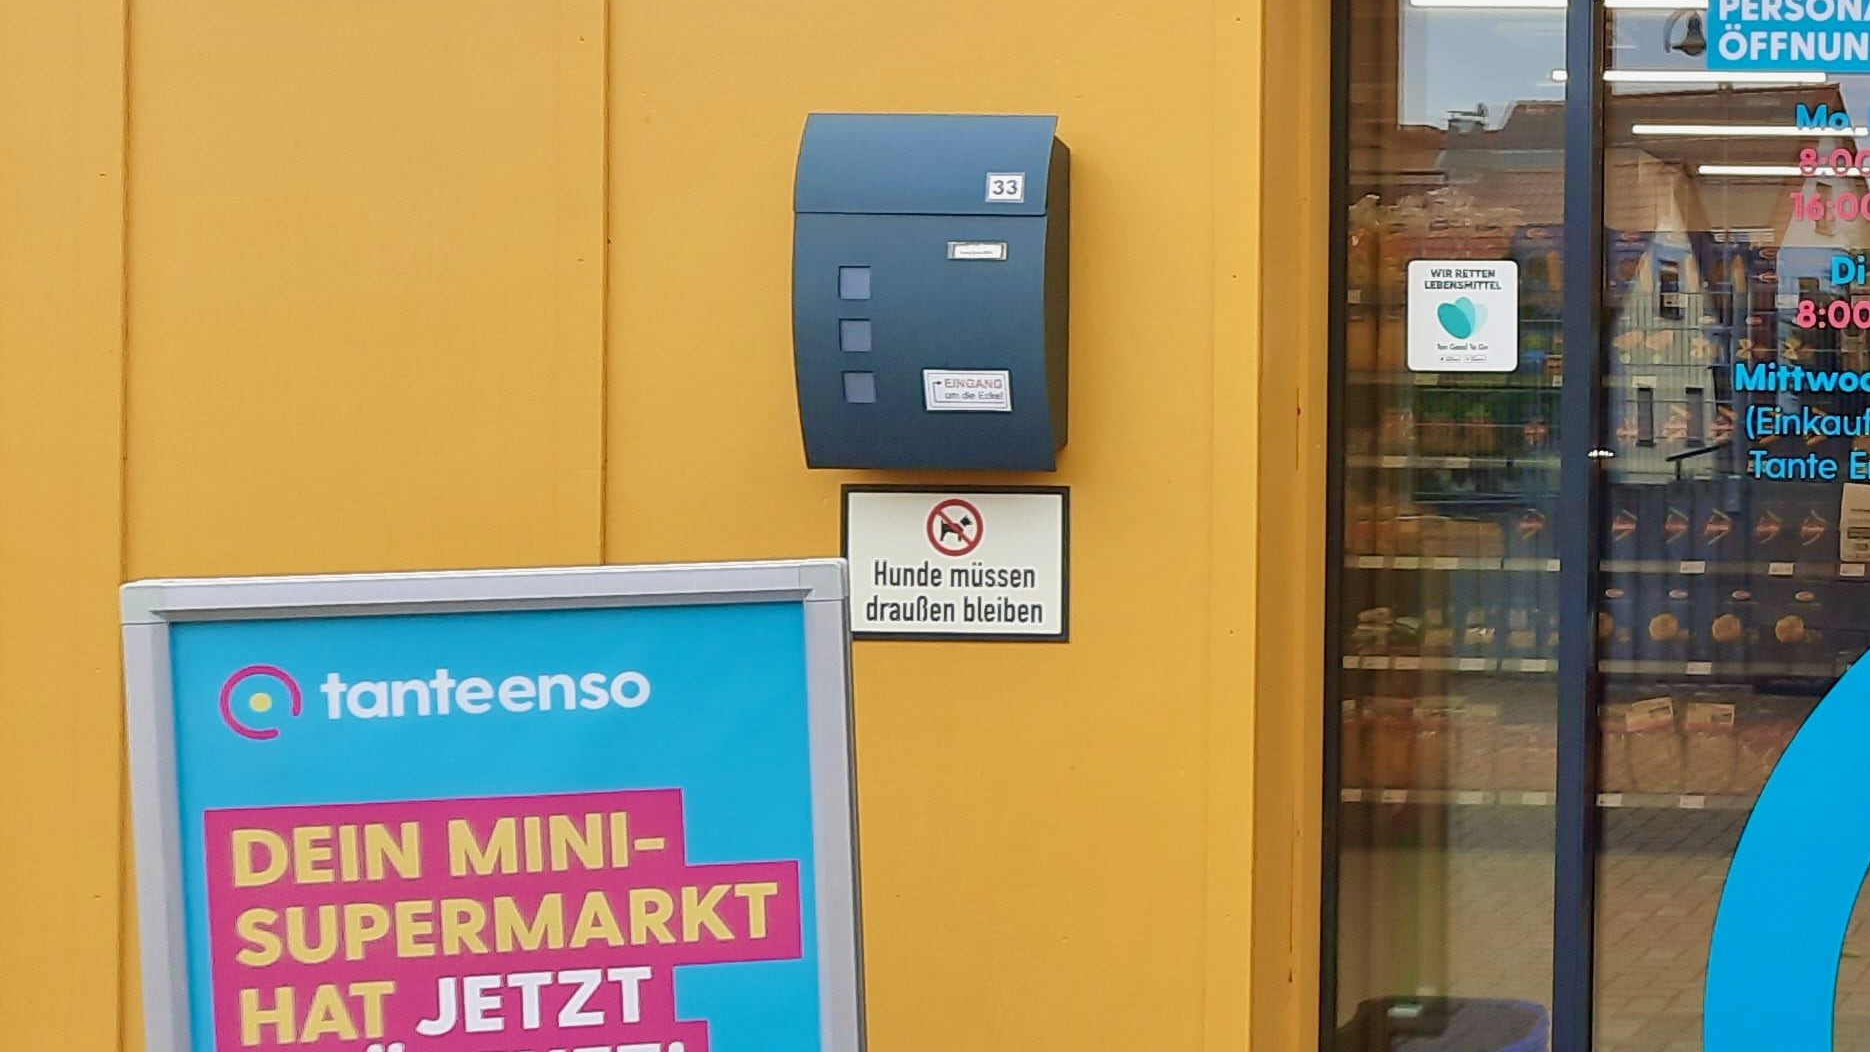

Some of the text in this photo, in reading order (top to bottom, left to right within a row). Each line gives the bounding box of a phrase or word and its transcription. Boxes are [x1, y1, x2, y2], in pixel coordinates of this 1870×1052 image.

[992, 179, 1018, 196] 33
[1431, 269, 1496, 278] WIR RETTEN
[1831, 255, 1865, 285] Di
[1424, 281, 1502, 290] LEBENSMITTEL
[944, 379, 1002, 389] EINGANG
[1748, 451, 1838, 481] Tante
[874, 561, 1036, 589] Hunde müssen
[866, 596, 1043, 624] draußen bleiben
[321, 668, 652, 721] tanteenso
[232, 811, 666, 888] DEIN MINI-
[236, 882, 779, 967] SUPERMARKT
[241, 966, 653, 1046] HAT JETZT
